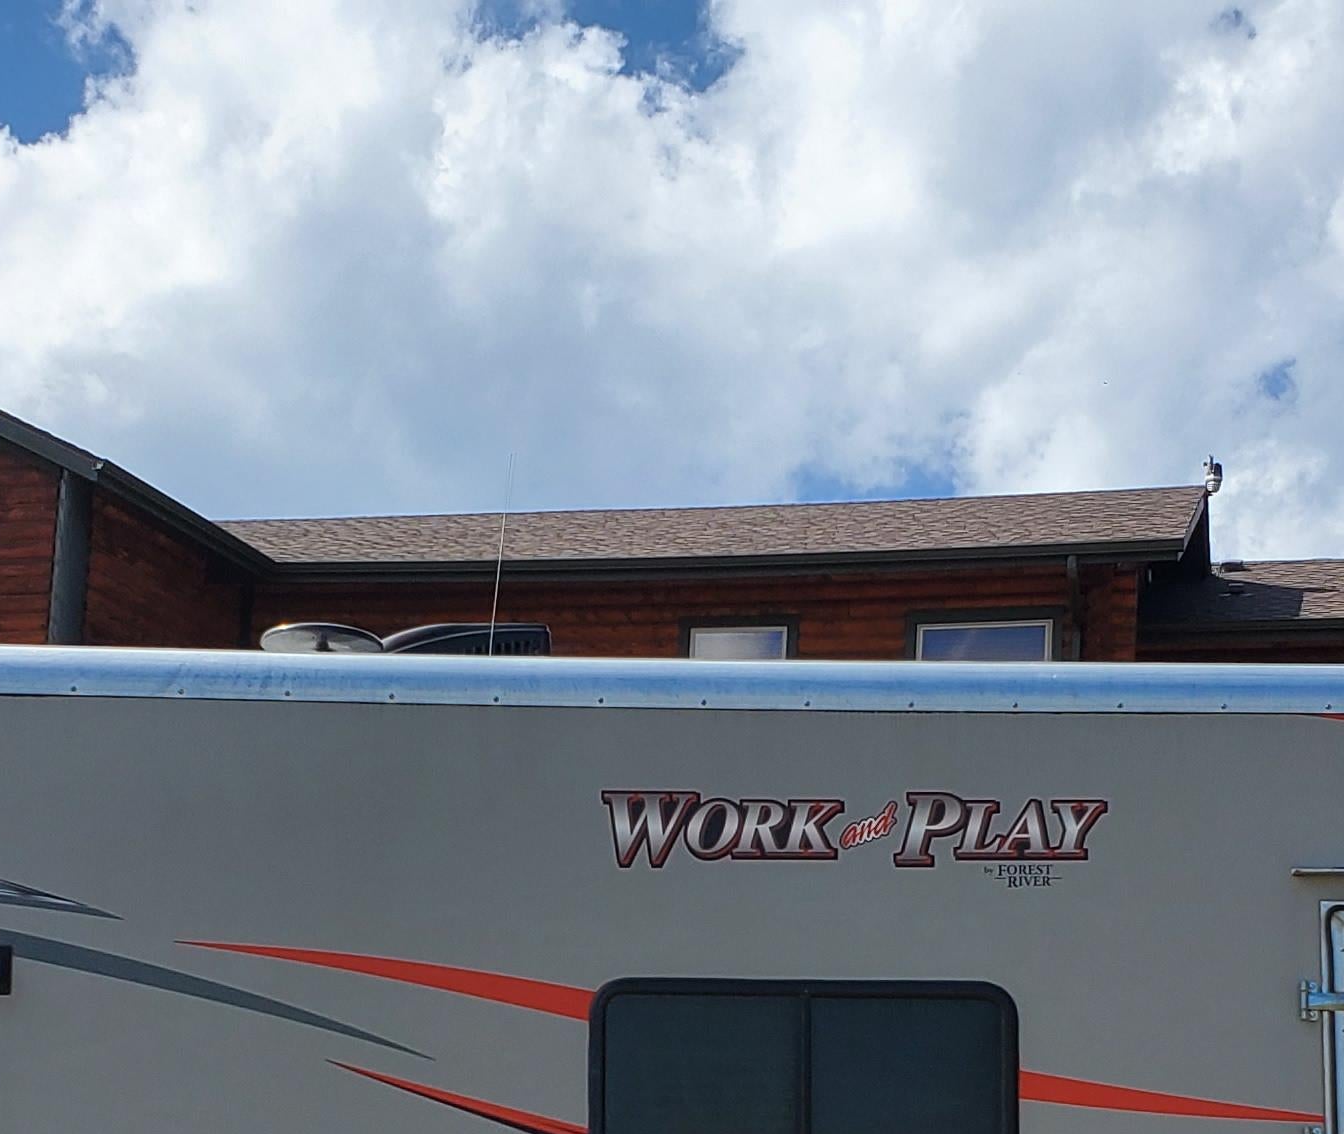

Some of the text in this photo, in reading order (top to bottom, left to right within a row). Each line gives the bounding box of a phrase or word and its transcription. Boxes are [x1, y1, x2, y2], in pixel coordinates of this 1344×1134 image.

[602, 789, 1108, 868] WORK and PLAY
[998, 864, 1053, 876] FOREST
[1008, 875, 1051, 888] RIVER
